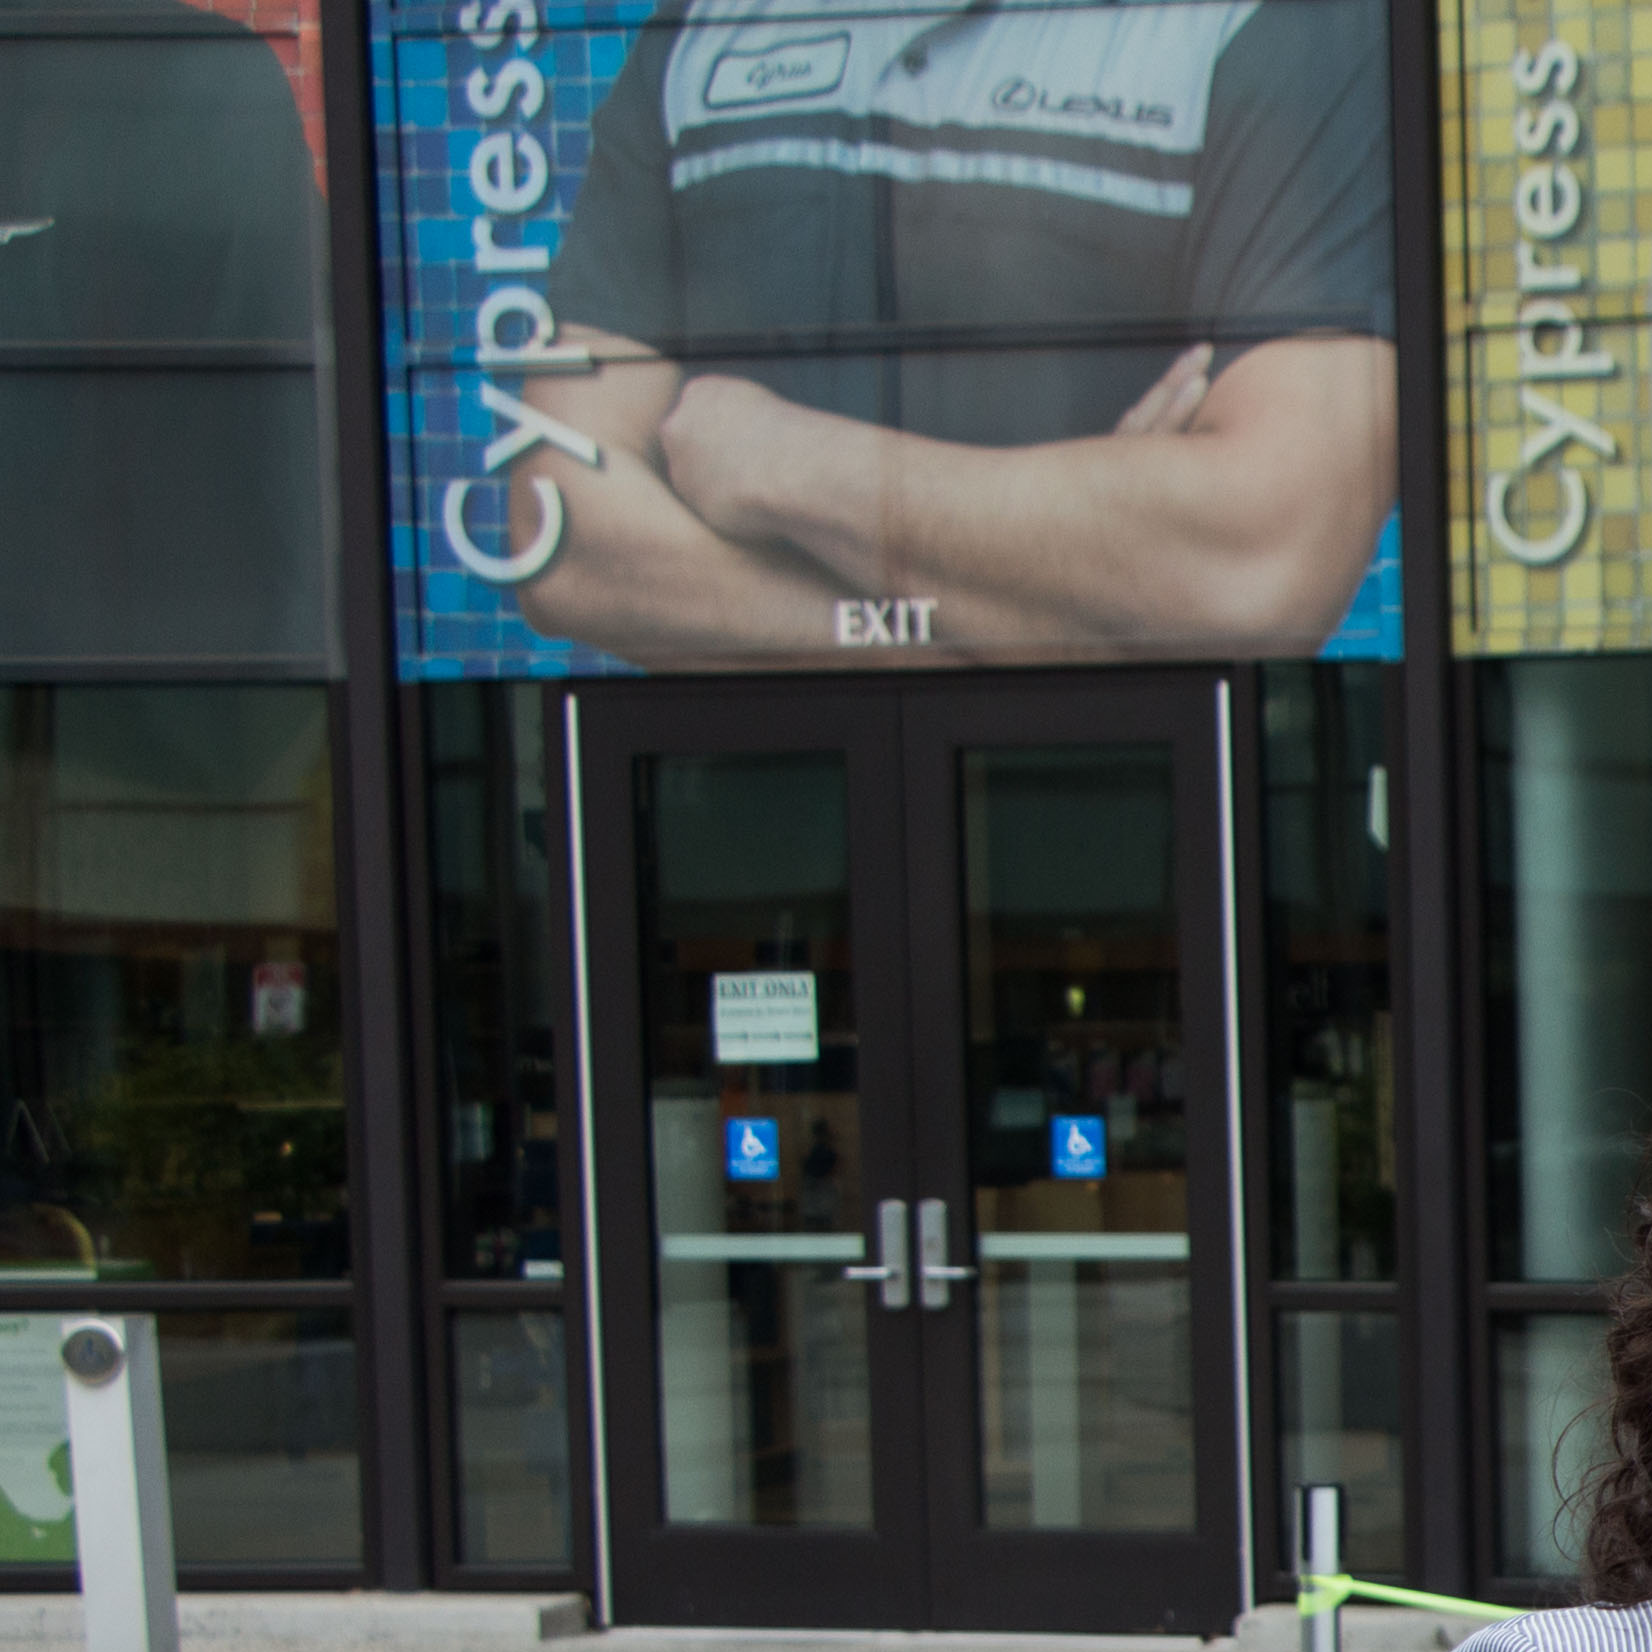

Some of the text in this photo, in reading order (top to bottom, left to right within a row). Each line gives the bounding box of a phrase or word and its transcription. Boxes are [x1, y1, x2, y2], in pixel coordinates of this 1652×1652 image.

[443, 0, 603, 586] Cypress
[1487, 39, 1617, 566] Cypress
[834, 598, 938, 647] EXIT
[719, 978, 810, 998] EXIT ONLY
